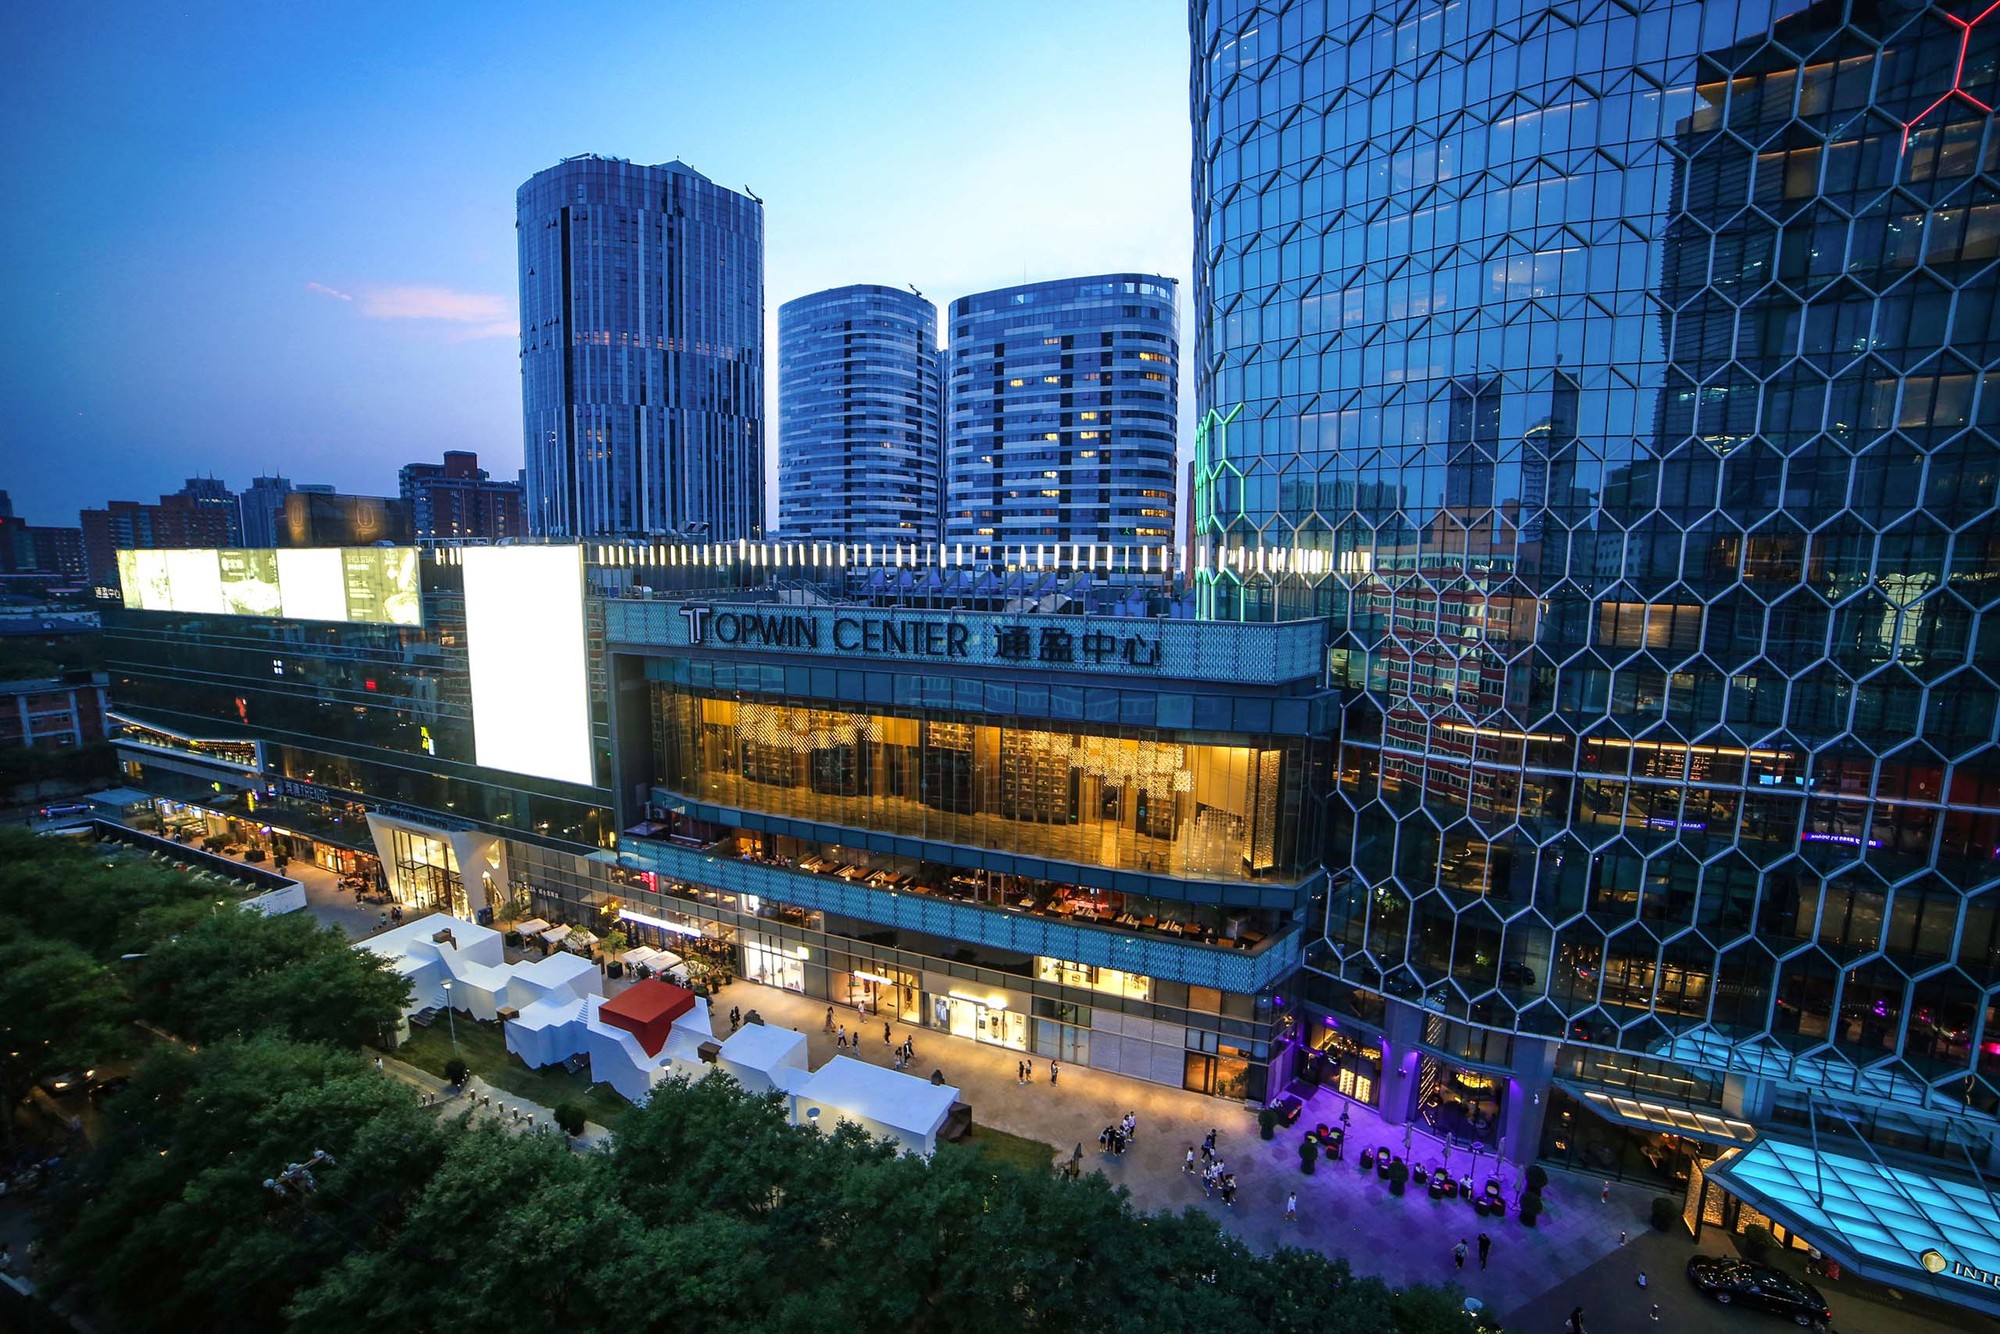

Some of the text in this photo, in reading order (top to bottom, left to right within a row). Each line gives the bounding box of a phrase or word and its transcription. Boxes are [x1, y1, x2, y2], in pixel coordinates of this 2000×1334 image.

[679, 607, 969, 657] TOPWIN CENTER
[993, 624, 1162, 666] 通盈中心
[300, 784, 329, 803] TRENDS
